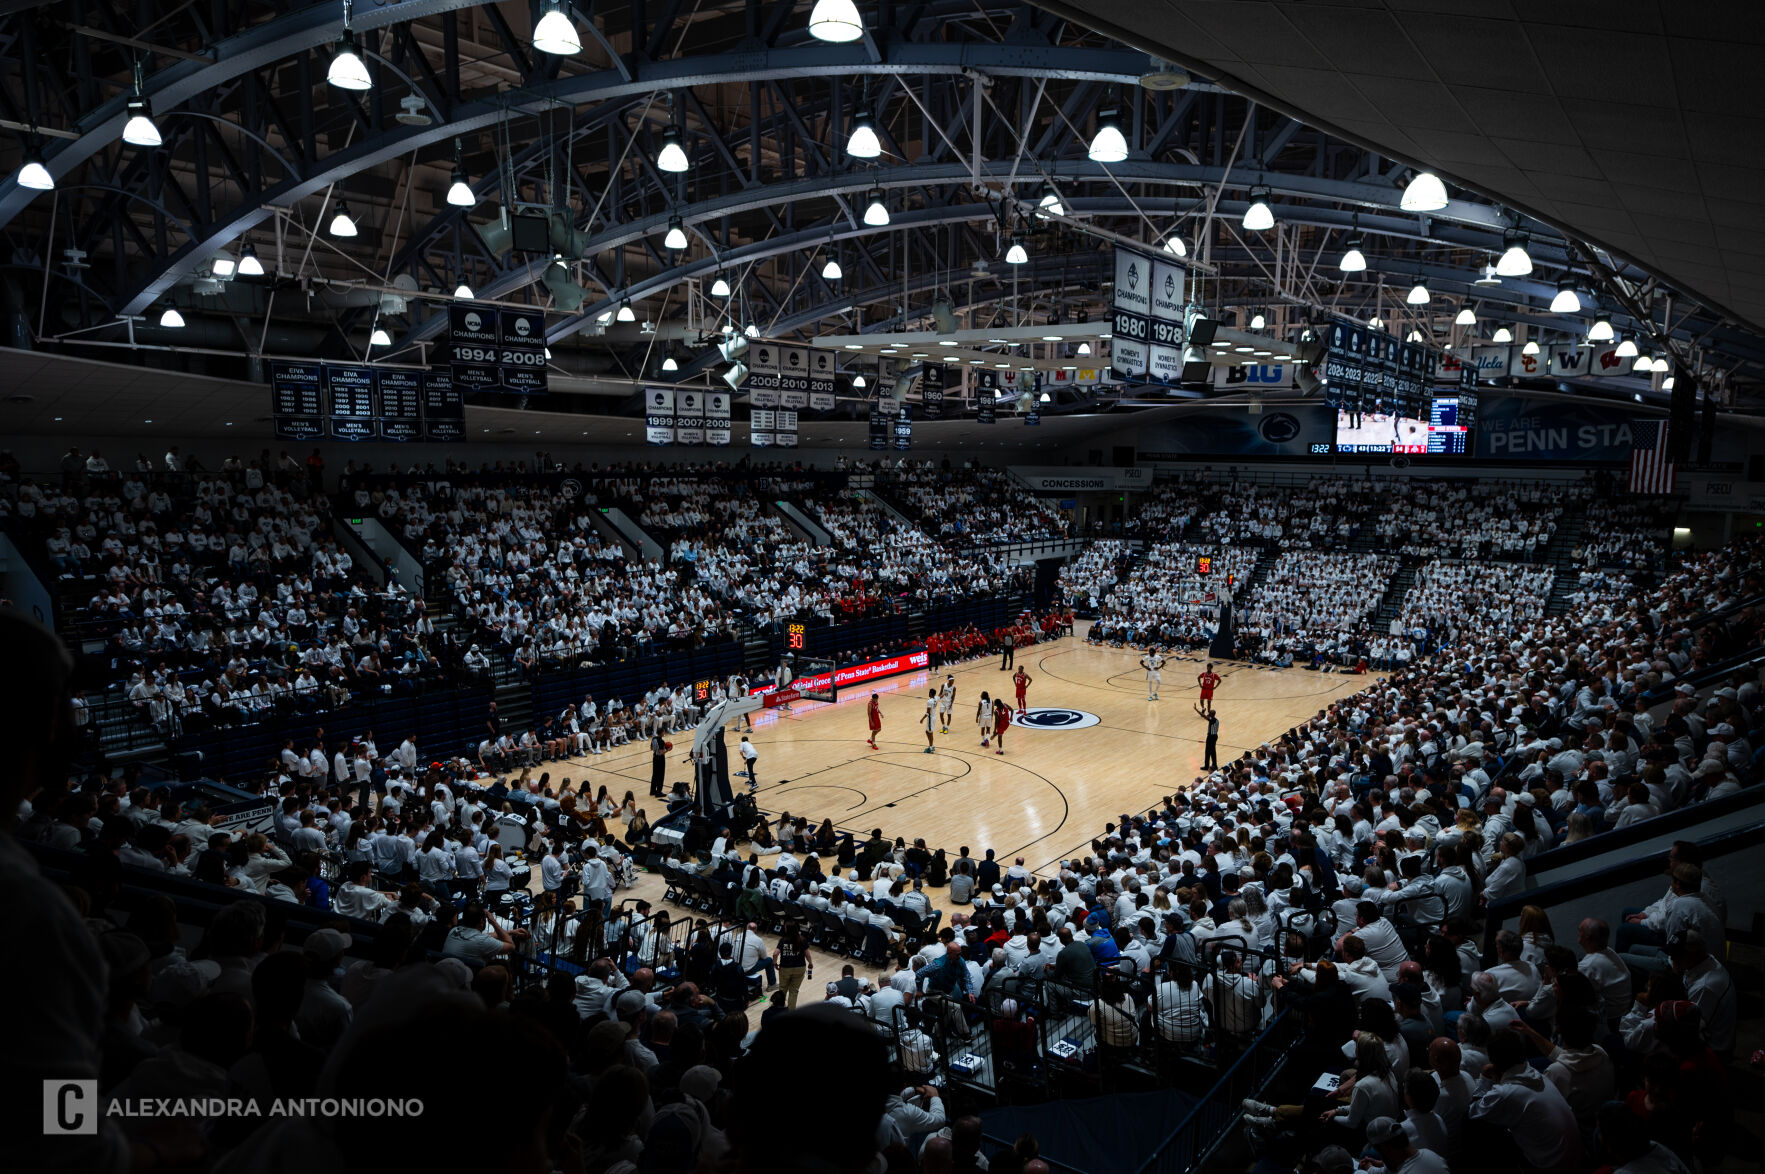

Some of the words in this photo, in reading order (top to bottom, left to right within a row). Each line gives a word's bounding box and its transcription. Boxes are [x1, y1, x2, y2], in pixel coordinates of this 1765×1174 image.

[1115, 315, 1146, 338] 1980
[453, 330, 495, 341] CHAMPIONS
[1153, 323, 1183, 344] 1978
[504, 335, 543, 345] CHAMPIONS
[452, 347, 496, 362] 1994
[502, 351, 546, 366] 2008
[1558, 352, 1585, 369] W
[1327, 363, 1345, 378] 2024
[1345, 367, 1362, 381] 2023
[276, 373, 318, 381] CHAMPIONS
[381, 379, 418, 387] CHAMPIONS
[750, 376, 780, 388] 2009
[1363, 372, 1379, 386] 2022
[782, 379, 808, 390] 2010
[811, 381, 834, 391] 2013
[880, 387, 891, 396] 20
[923, 391, 942, 400] 1960
[648, 417, 673, 426] 1999
[677, 418, 703, 427] 2007
[705, 419, 730, 428] 2008
[1481, 420, 1505, 432] WE
[1511, 416, 1543, 431] ARE
[895, 427, 911, 435] 1959
[1489, 427, 1568, 454] PENN
[1577, 423, 1633, 448] STA
[1042, 479, 1104, 488] CONCESSIONS
[1706, 483, 1732, 495] PSECU
[1199, 563, 1210, 573] 30
[790, 633, 803, 648] 30
[909, 652, 928, 665] weis
[814, 677, 832, 688] Groce
[834, 673, 841, 682] of
[841, 669, 855, 681] Penn
[872, 661, 899, 674] Basketball
[697, 689, 708, 700] 30
[236, 812, 251, 820] ARE
[252, 808, 273, 817] PENN
